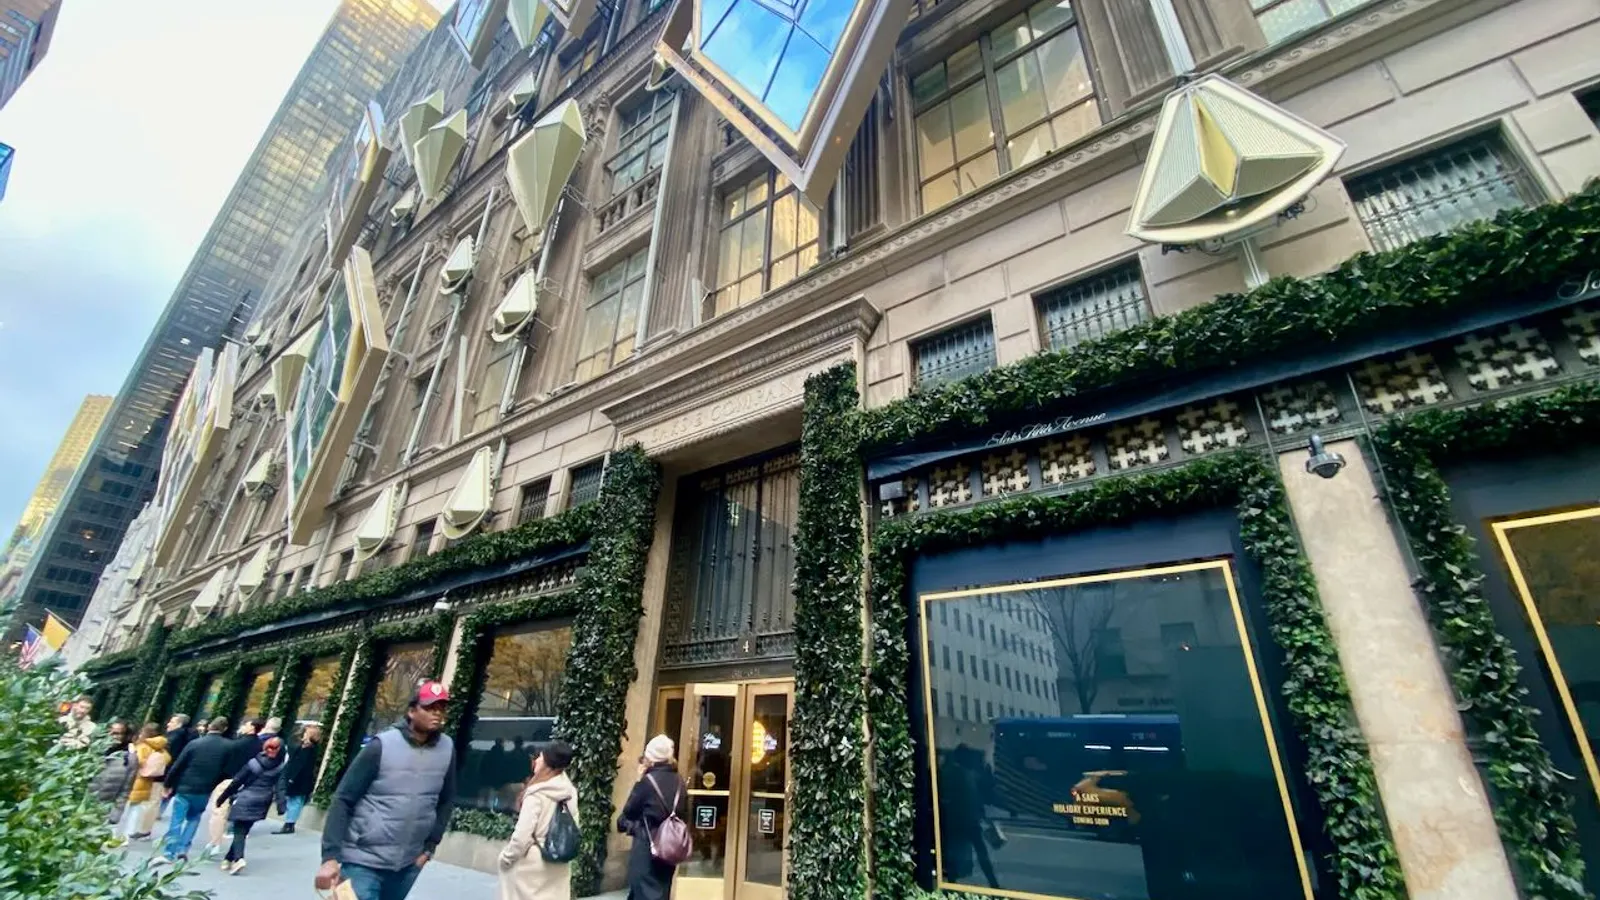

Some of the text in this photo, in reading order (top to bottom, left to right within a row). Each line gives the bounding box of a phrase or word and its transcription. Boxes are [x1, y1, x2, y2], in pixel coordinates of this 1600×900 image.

[985, 411, 1107, 447] Saks Fifth Avenue
[742, 639, 750, 653] 4
[1075, 793, 1100, 803] A SAKS
[1052, 803, 1128, 817] HOLIDAY EXPERIENCE
[1072, 816, 1110, 826] COMING SOON
